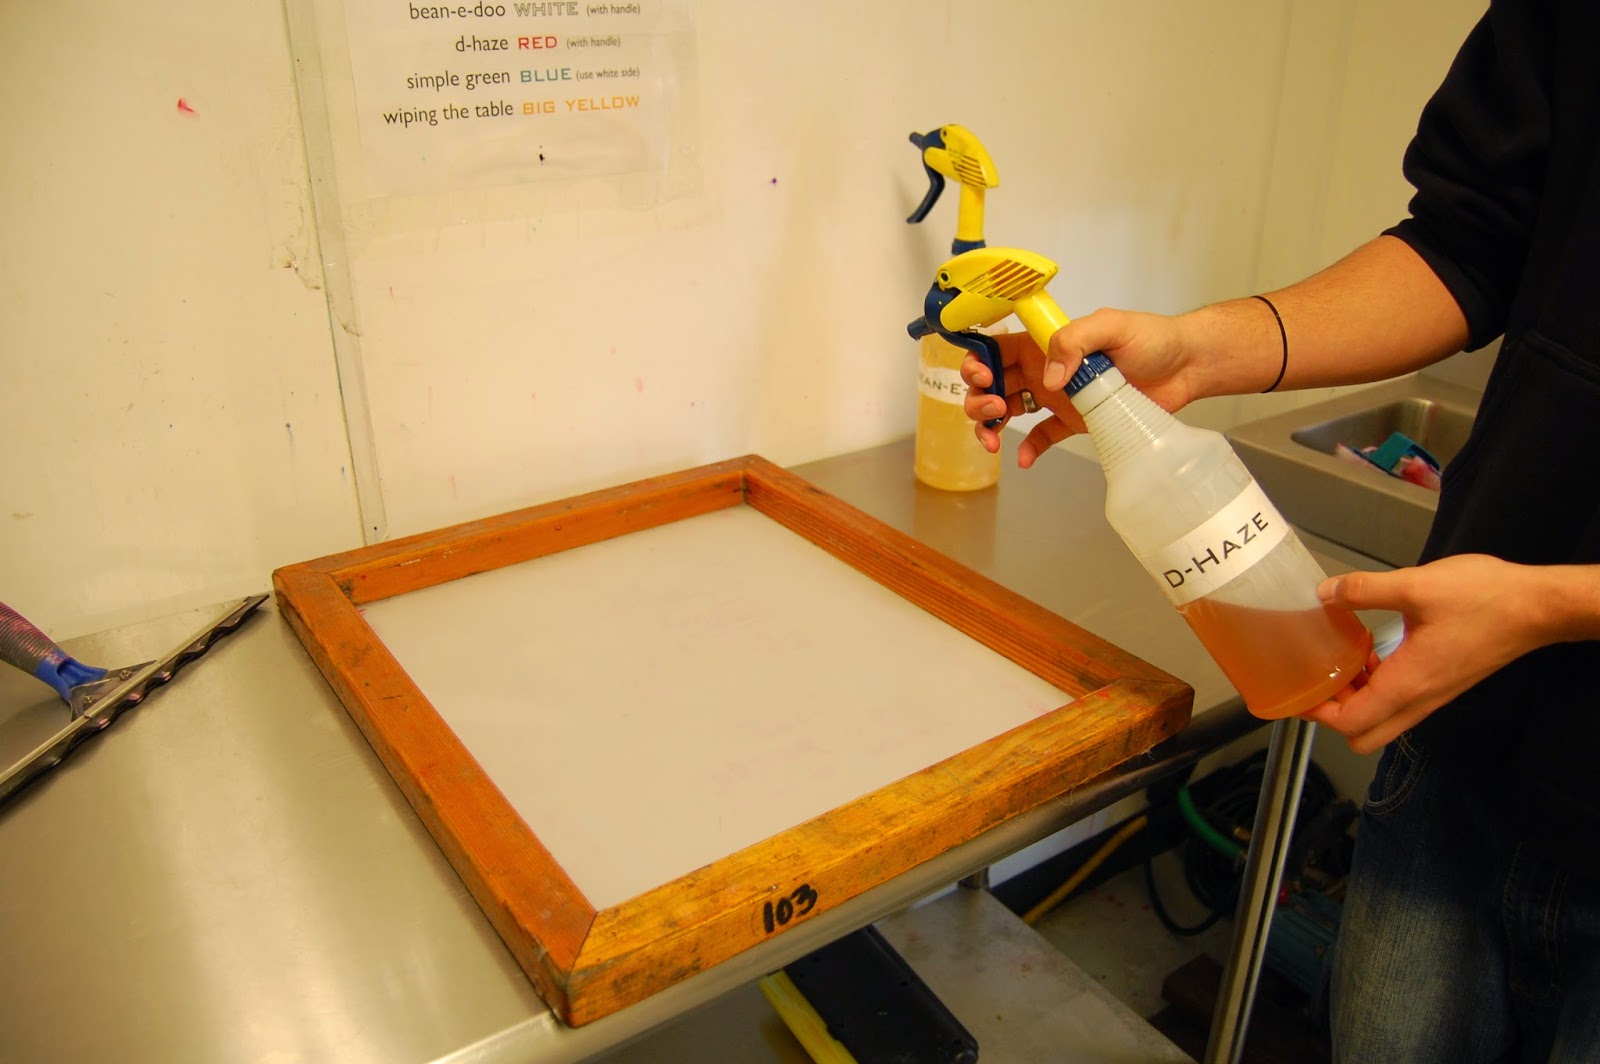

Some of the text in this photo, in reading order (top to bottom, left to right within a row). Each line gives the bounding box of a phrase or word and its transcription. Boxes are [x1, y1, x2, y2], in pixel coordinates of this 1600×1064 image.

[409, 1, 641, 20] bean-e-doo WHITE (with handle)
[455, 35, 621, 52] d-haze RED (with handle)
[406, 67, 640, 92] simple green BLUE (use white side)
[383, 96, 640, 128] wiping the table BIG YELLOW
[1162, 511, 1269, 589] D-HAZE
[763, 883, 818, 934] 103
